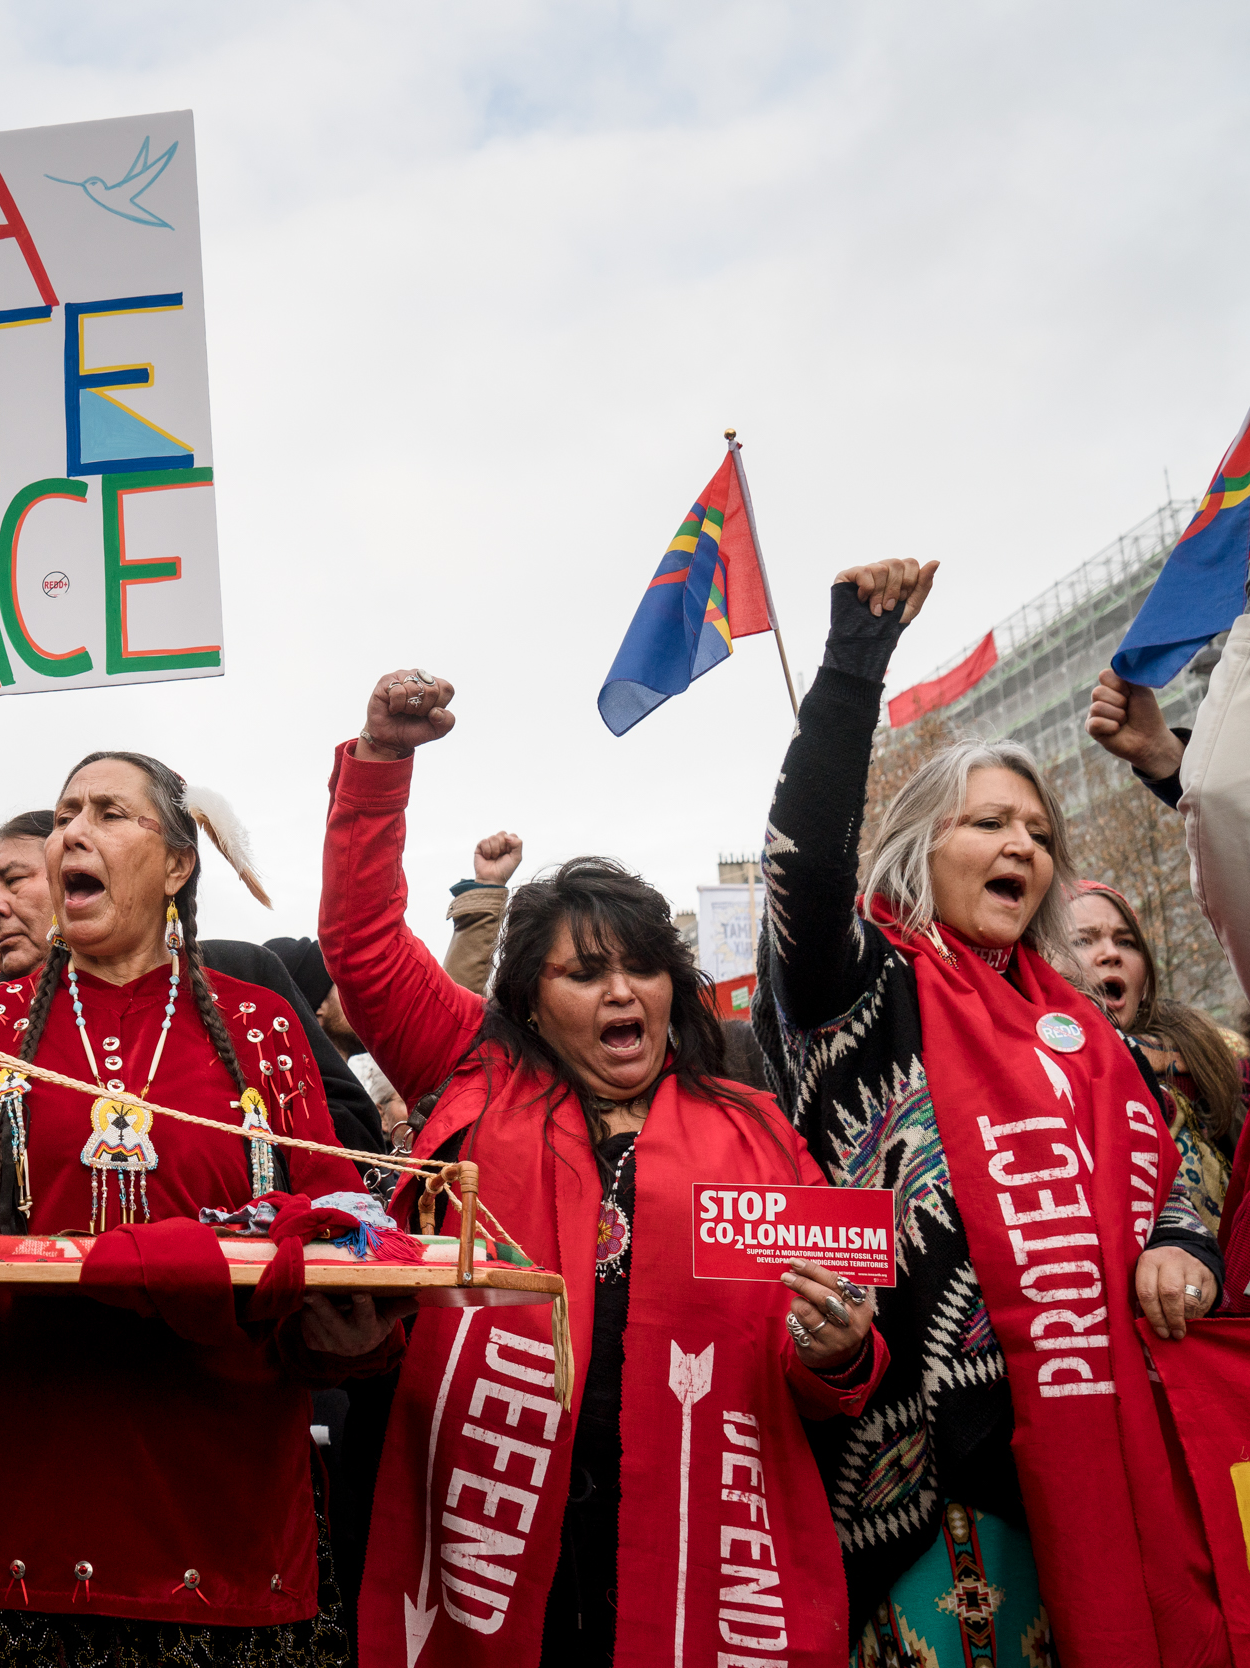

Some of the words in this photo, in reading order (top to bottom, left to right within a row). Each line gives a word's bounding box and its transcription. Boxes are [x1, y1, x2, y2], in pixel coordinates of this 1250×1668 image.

[44, 581, 68, 589] REDD+
[700, 1190, 787, 1221] STOP
[700, 1221, 888, 1250] CO2LONIALISM
[746, 1248, 774, 1256] SUPPORT
[781, 1250, 824, 1258] MORATORIUM
[851, 1252, 872, 1260] FOSSIL
[850, 1260, 888, 1269] TERRITORIES
[977, 1115, 1116, 1398] PROTECT
[441, 1326, 562, 1635] DEFEND
